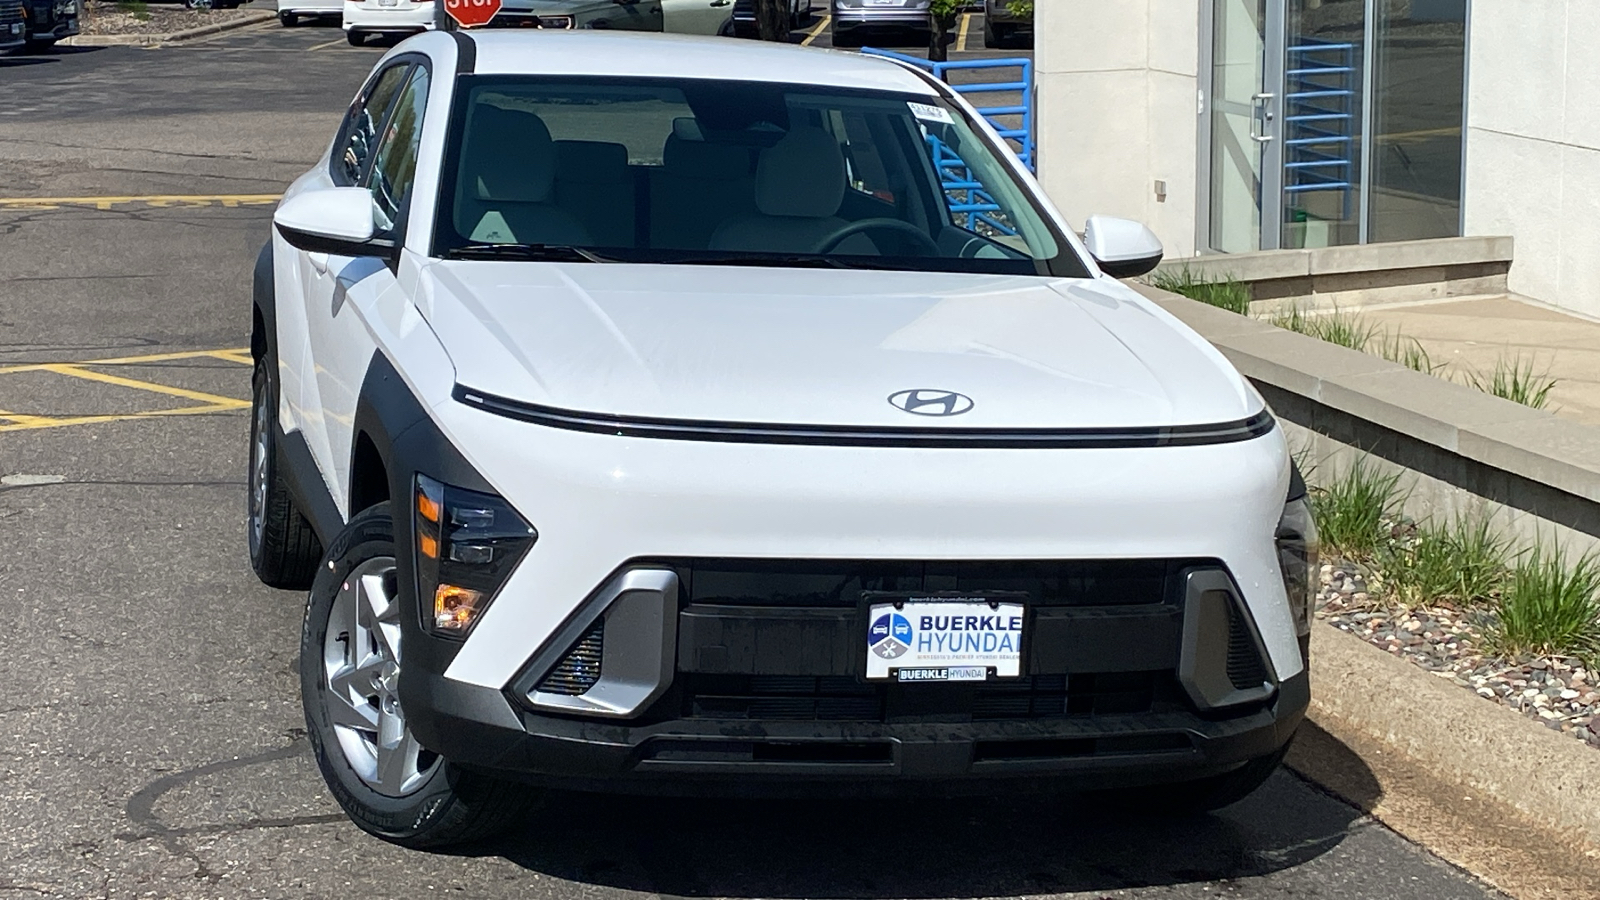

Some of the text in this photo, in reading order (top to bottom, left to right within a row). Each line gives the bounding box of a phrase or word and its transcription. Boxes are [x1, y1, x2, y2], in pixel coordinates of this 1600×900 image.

[919, 615, 1023, 631] BUERKLE
[918, 632, 1022, 652] HYUNDAI
[900, 668, 985, 680] BUERKLE HYUNDAI
